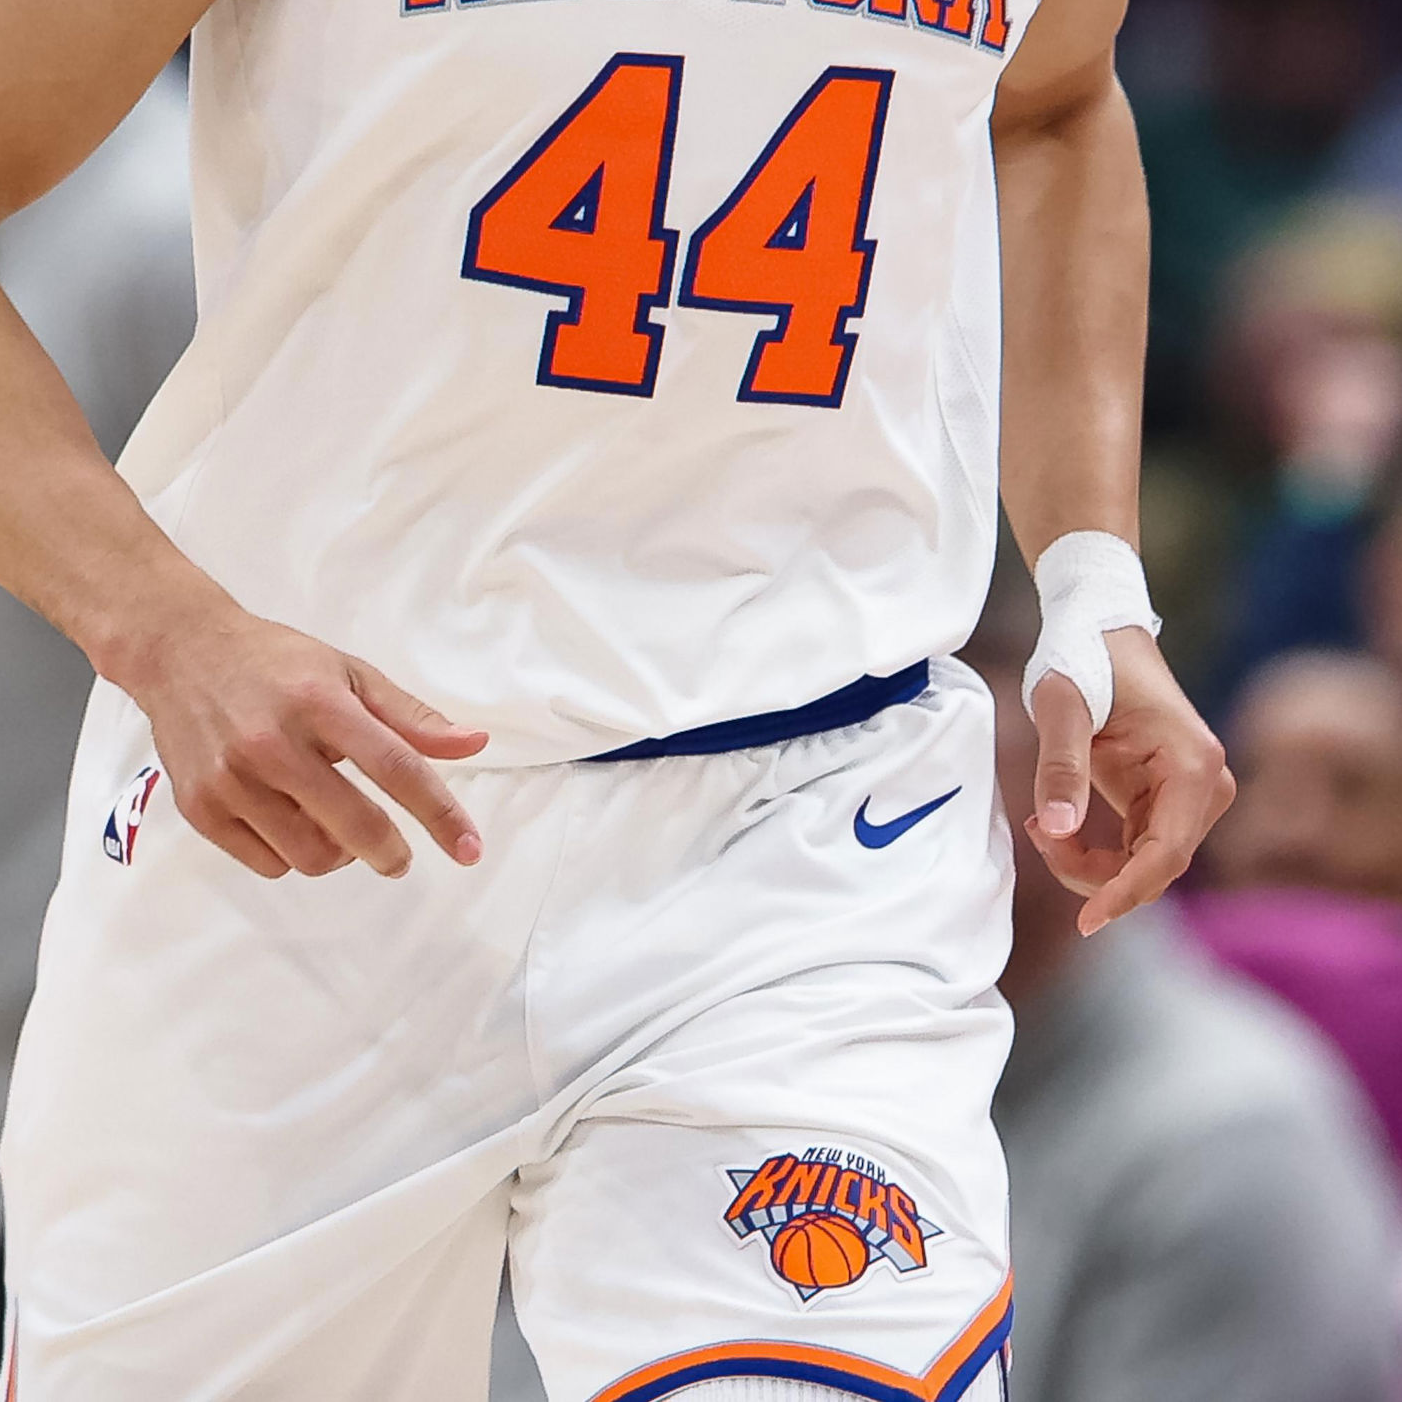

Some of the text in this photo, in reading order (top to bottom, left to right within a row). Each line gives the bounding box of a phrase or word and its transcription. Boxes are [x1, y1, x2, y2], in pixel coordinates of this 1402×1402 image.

[461, 52, 896, 409] 44
[724, 1153, 927, 1270] KNICKS
[803, 1147, 886, 1183] NEW YORK
